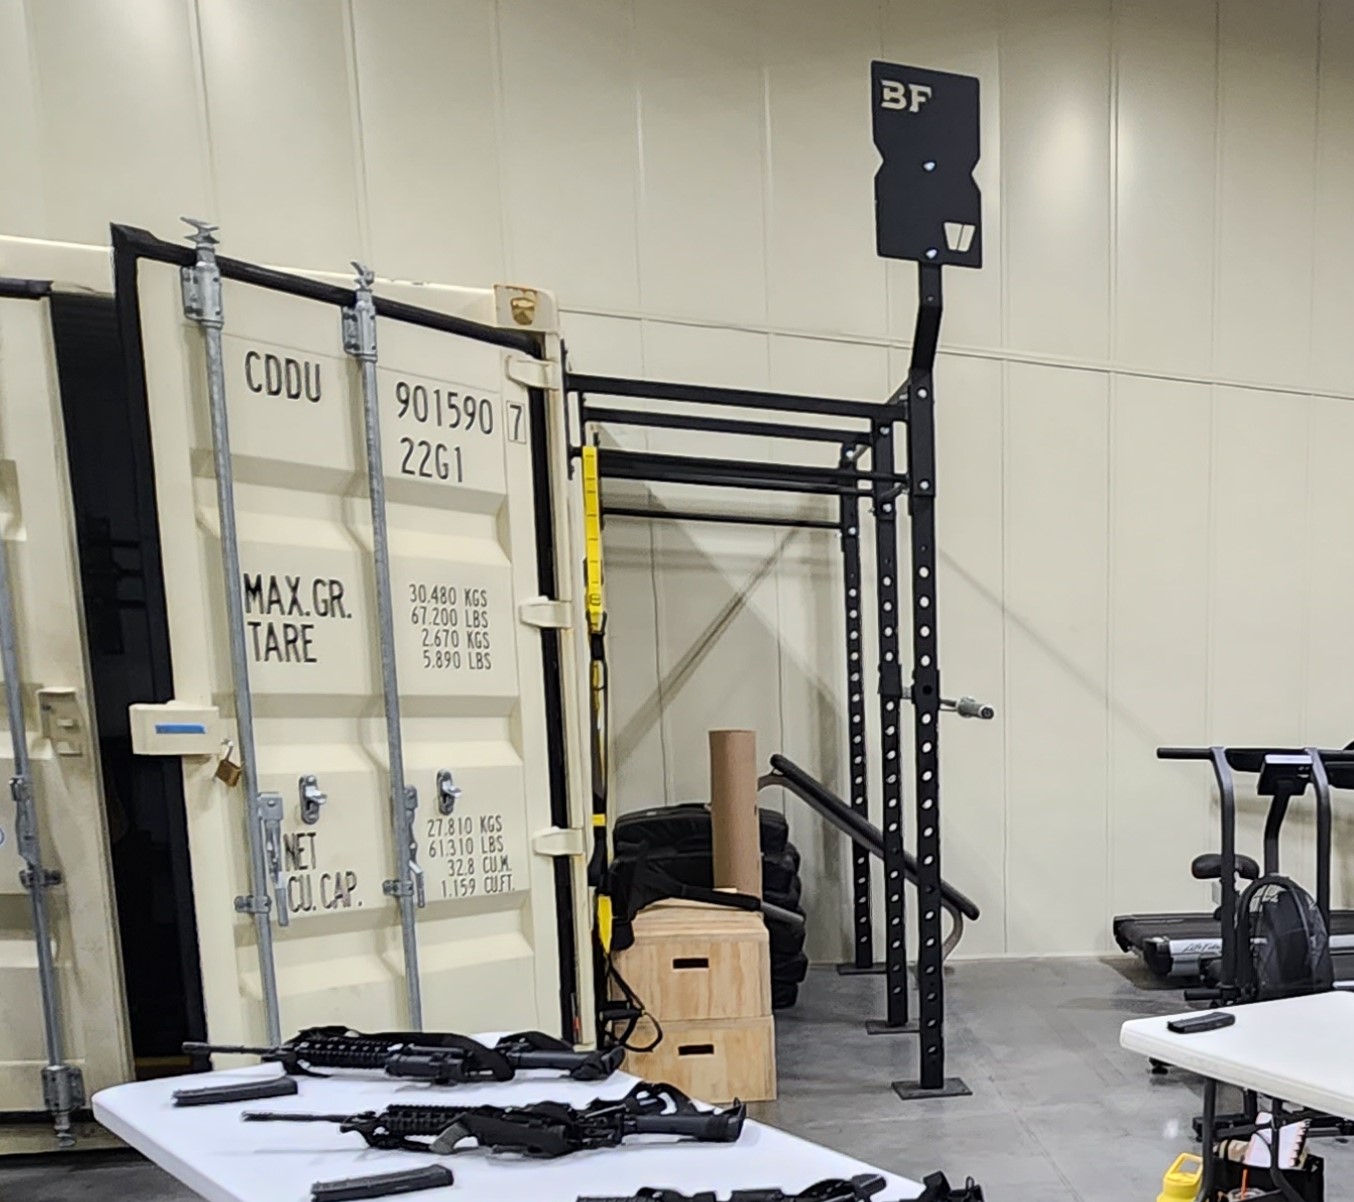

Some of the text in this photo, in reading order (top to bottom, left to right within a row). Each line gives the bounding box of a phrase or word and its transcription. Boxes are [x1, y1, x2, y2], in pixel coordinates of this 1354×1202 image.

[880, 79, 933, 113] BF
[245, 350, 322, 403] CDDU
[396, 381, 523, 441] 901590 7
[400, 437, 463, 483] 22G1
[409, 583, 488, 608] 30.480 KGS
[411, 606, 489, 629] 67.200 LBS
[247, 621, 318, 663] TARE
[422, 628, 490, 650] 2.670 KGS
[423, 649, 492, 670] 5.890 LBS
[427, 815, 503, 838] 27.810 KGS
[283, 831, 317, 872] NET
[429, 835, 504, 858] 61.310 LBS
[447, 857, 475, 877] 32.8
[441, 878, 476, 898] 1.159
